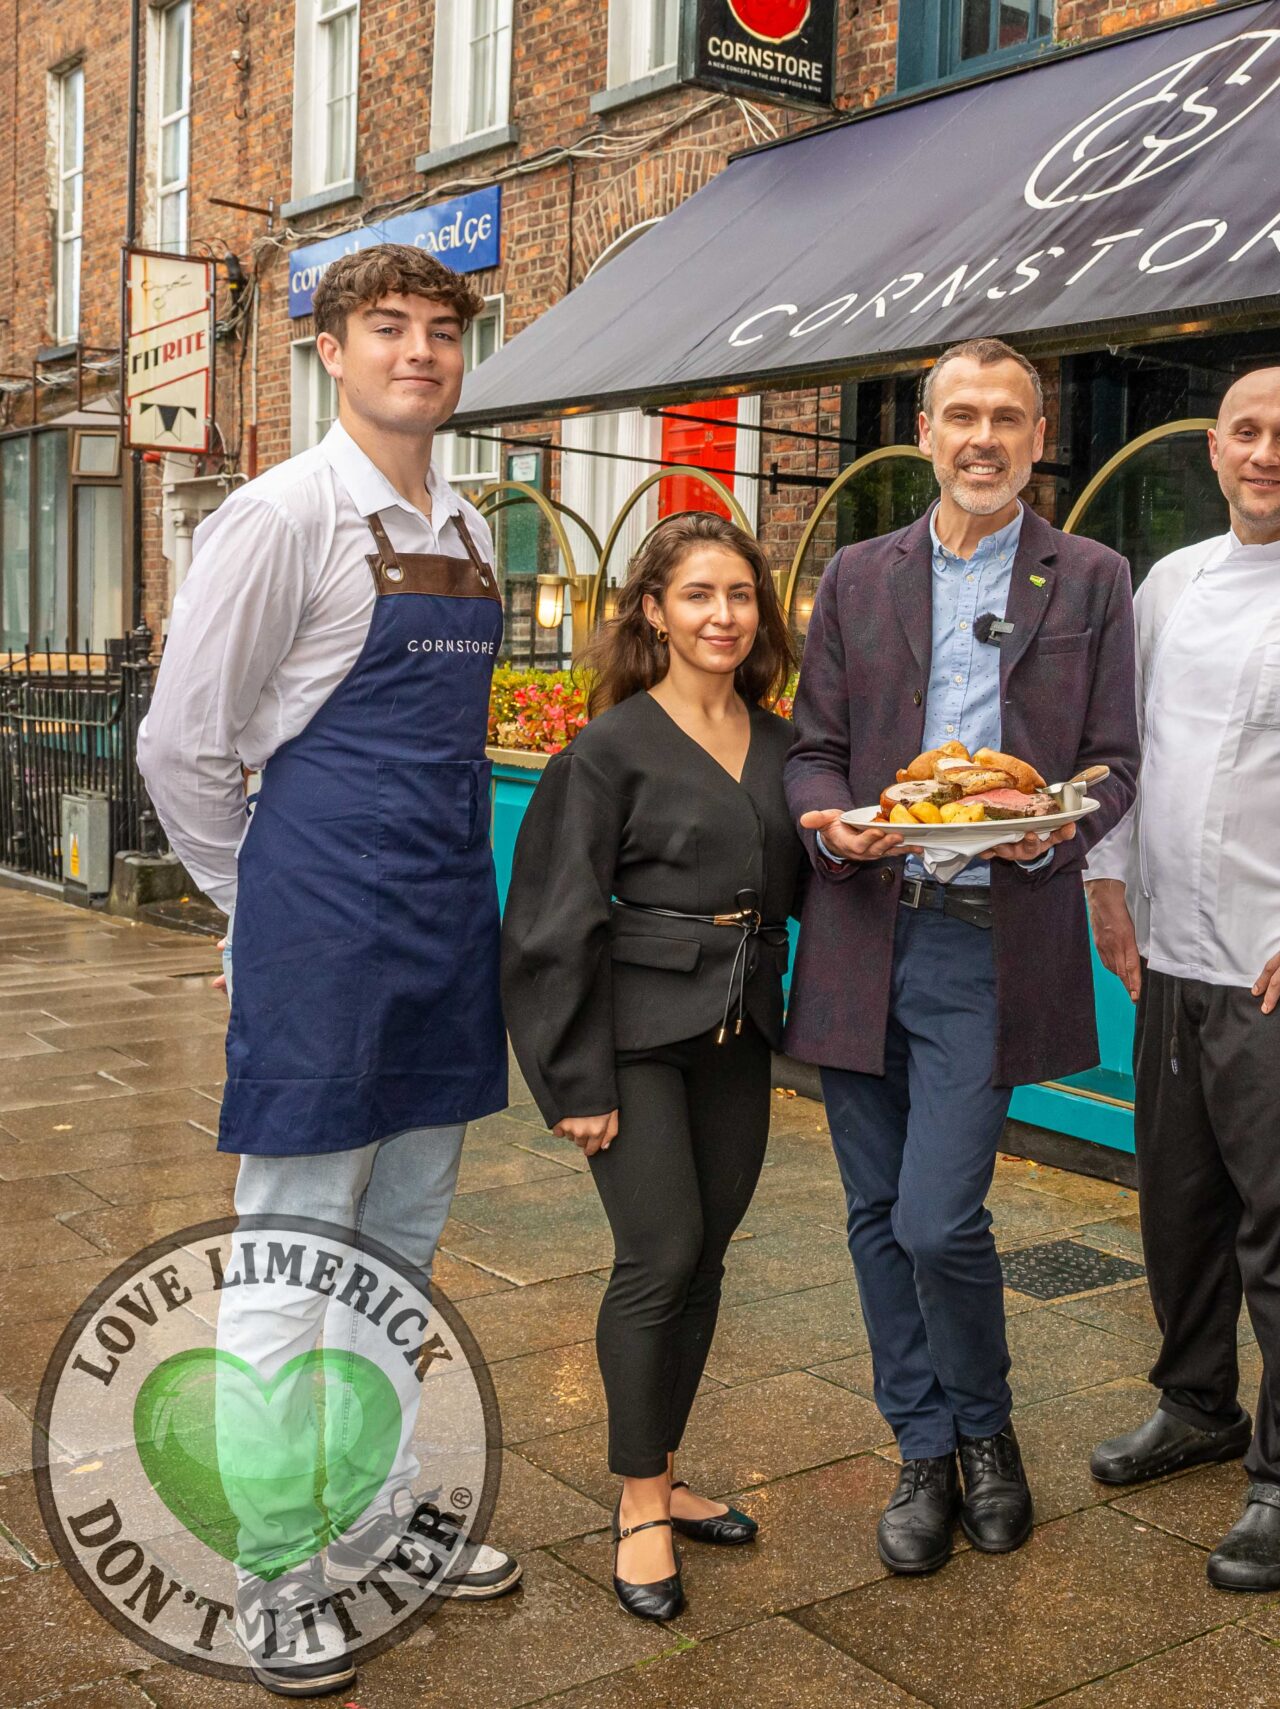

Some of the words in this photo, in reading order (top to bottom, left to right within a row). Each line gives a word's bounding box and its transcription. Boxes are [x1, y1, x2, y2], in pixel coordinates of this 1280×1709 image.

[708, 36, 823, 83] CORNSTORE
[726, 64, 750, 75] CONCEPT
[759, 72, 768, 80] THE
[132, 329, 206, 375] FITRITE
[407, 639, 494, 655] CORNSTORE
